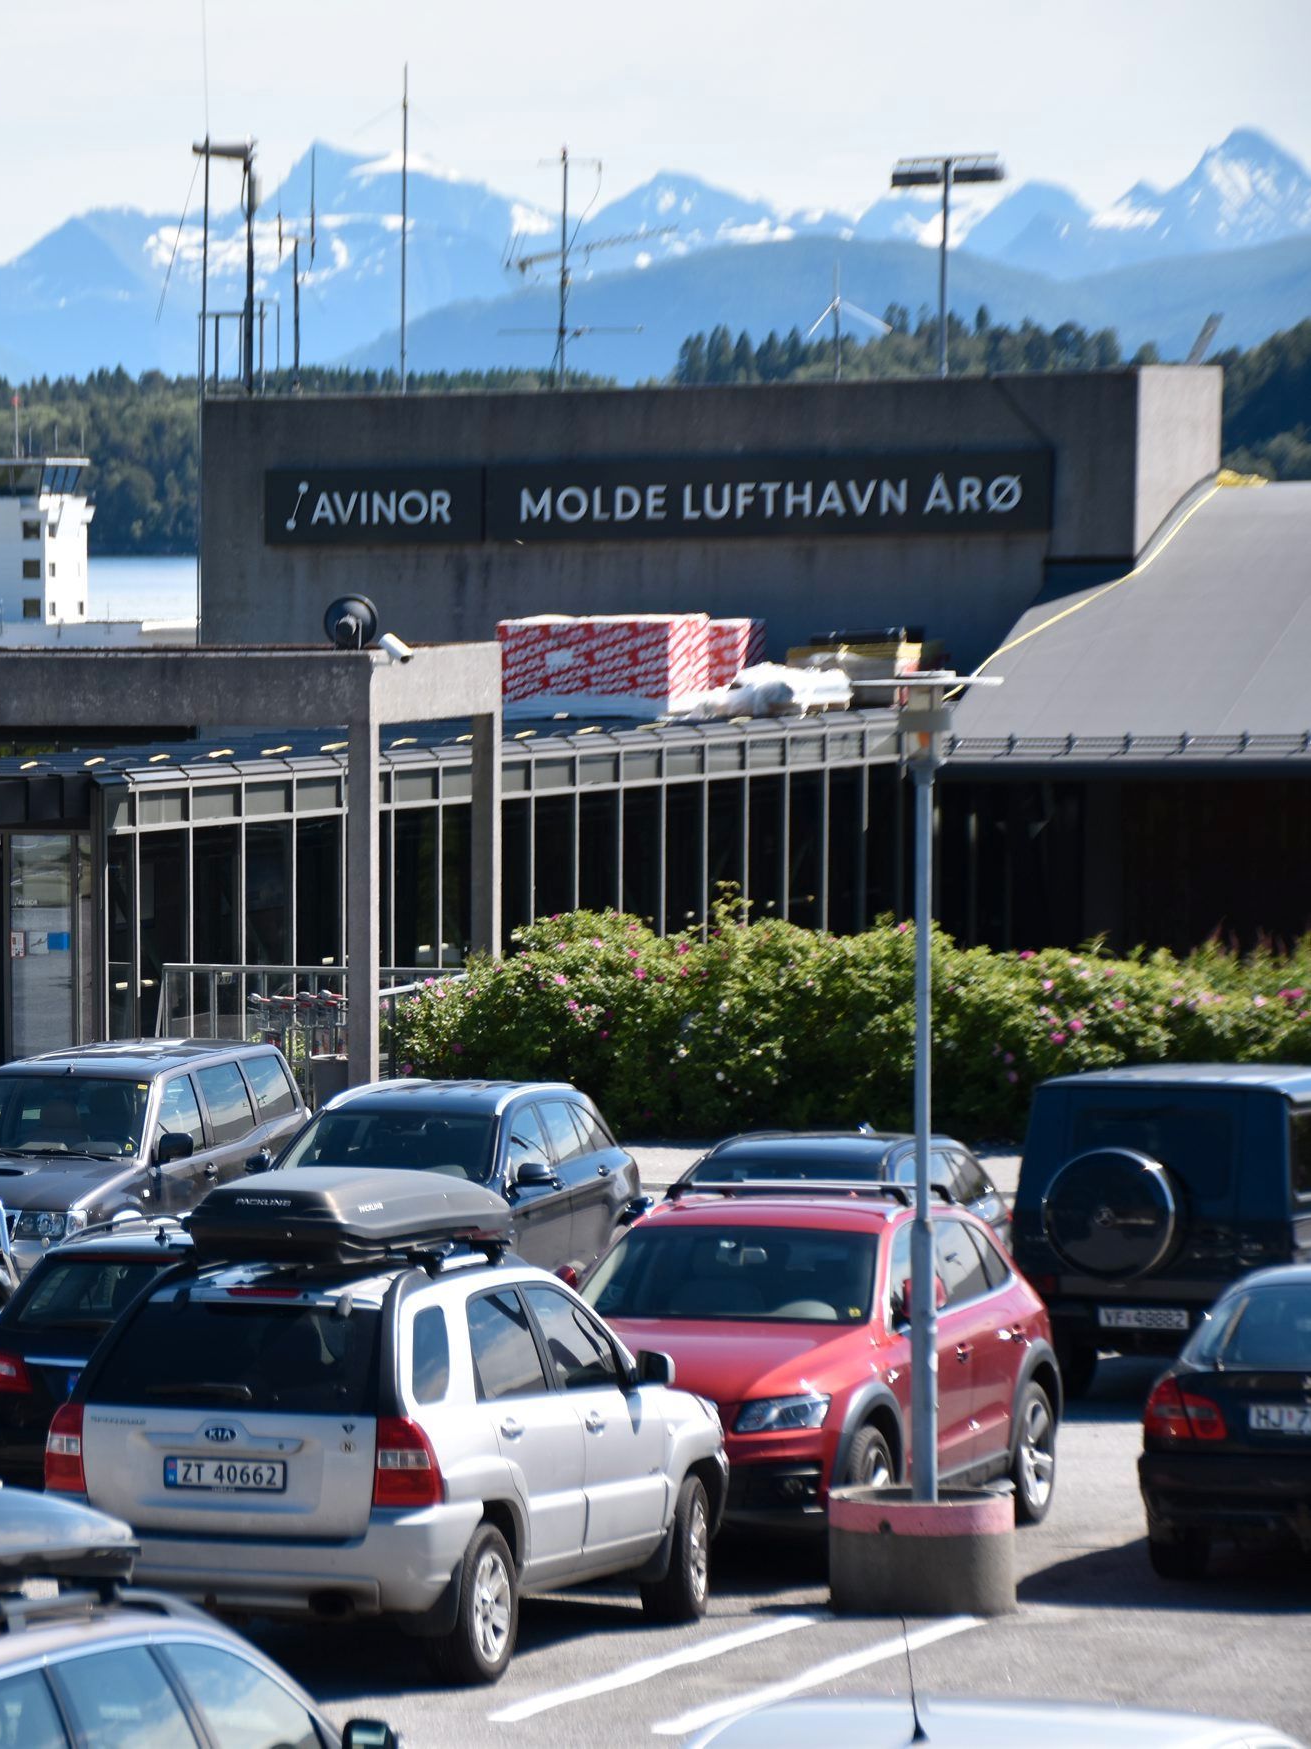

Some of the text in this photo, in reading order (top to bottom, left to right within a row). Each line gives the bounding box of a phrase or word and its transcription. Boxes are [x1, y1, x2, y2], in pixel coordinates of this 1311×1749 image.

[311, 490, 452, 526] AVINOR
[519, 472, 1023, 523] MOLDE LUFTHAVN ÅRØ
[208, 1427, 232, 1440] KIA
[182, 1463, 276, 1486] ZT 40662
